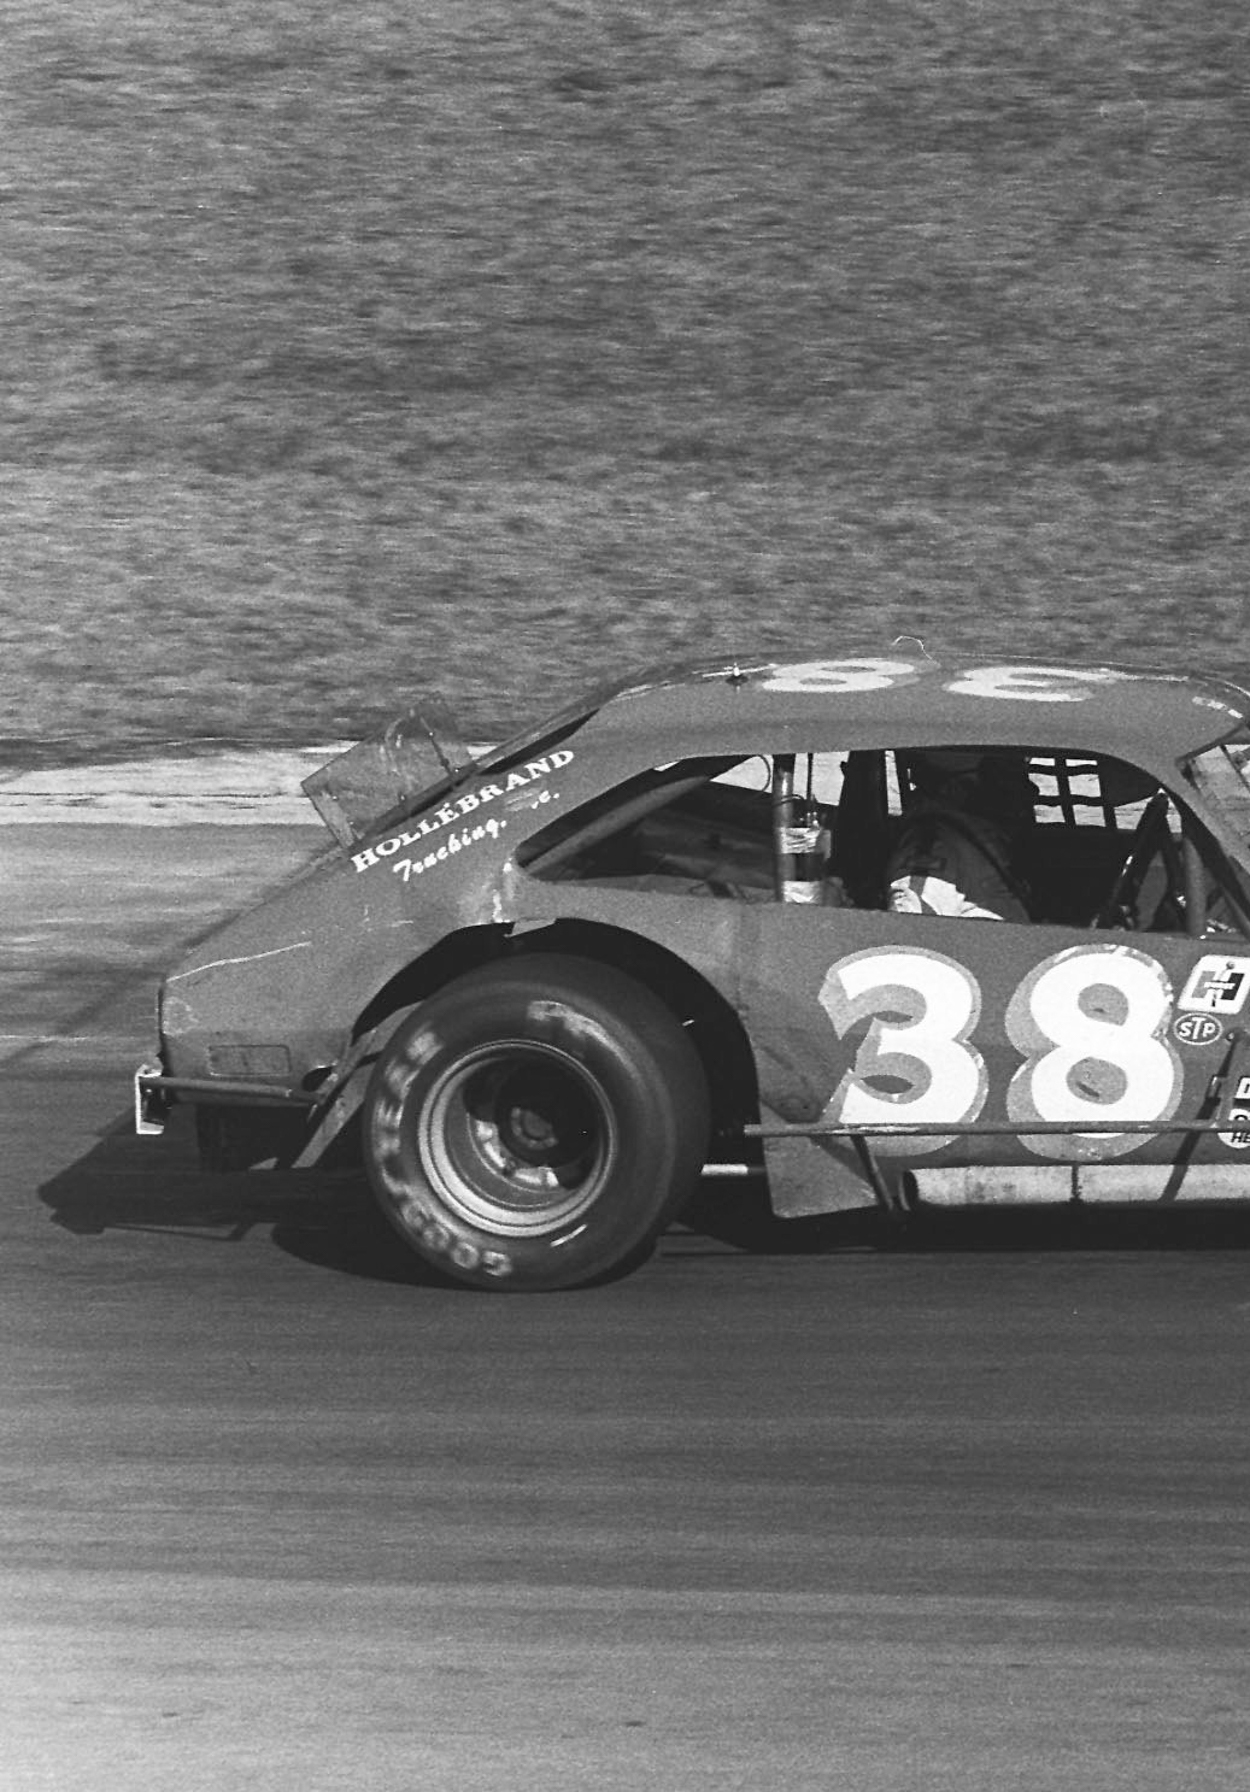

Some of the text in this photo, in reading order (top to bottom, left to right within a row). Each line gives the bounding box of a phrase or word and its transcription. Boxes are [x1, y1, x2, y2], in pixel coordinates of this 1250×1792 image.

[350, 750, 575, 873] HOLLEBRAND
[818, 944, 1184, 1161] 38
[1179, 1016, 1217, 1040] STP
